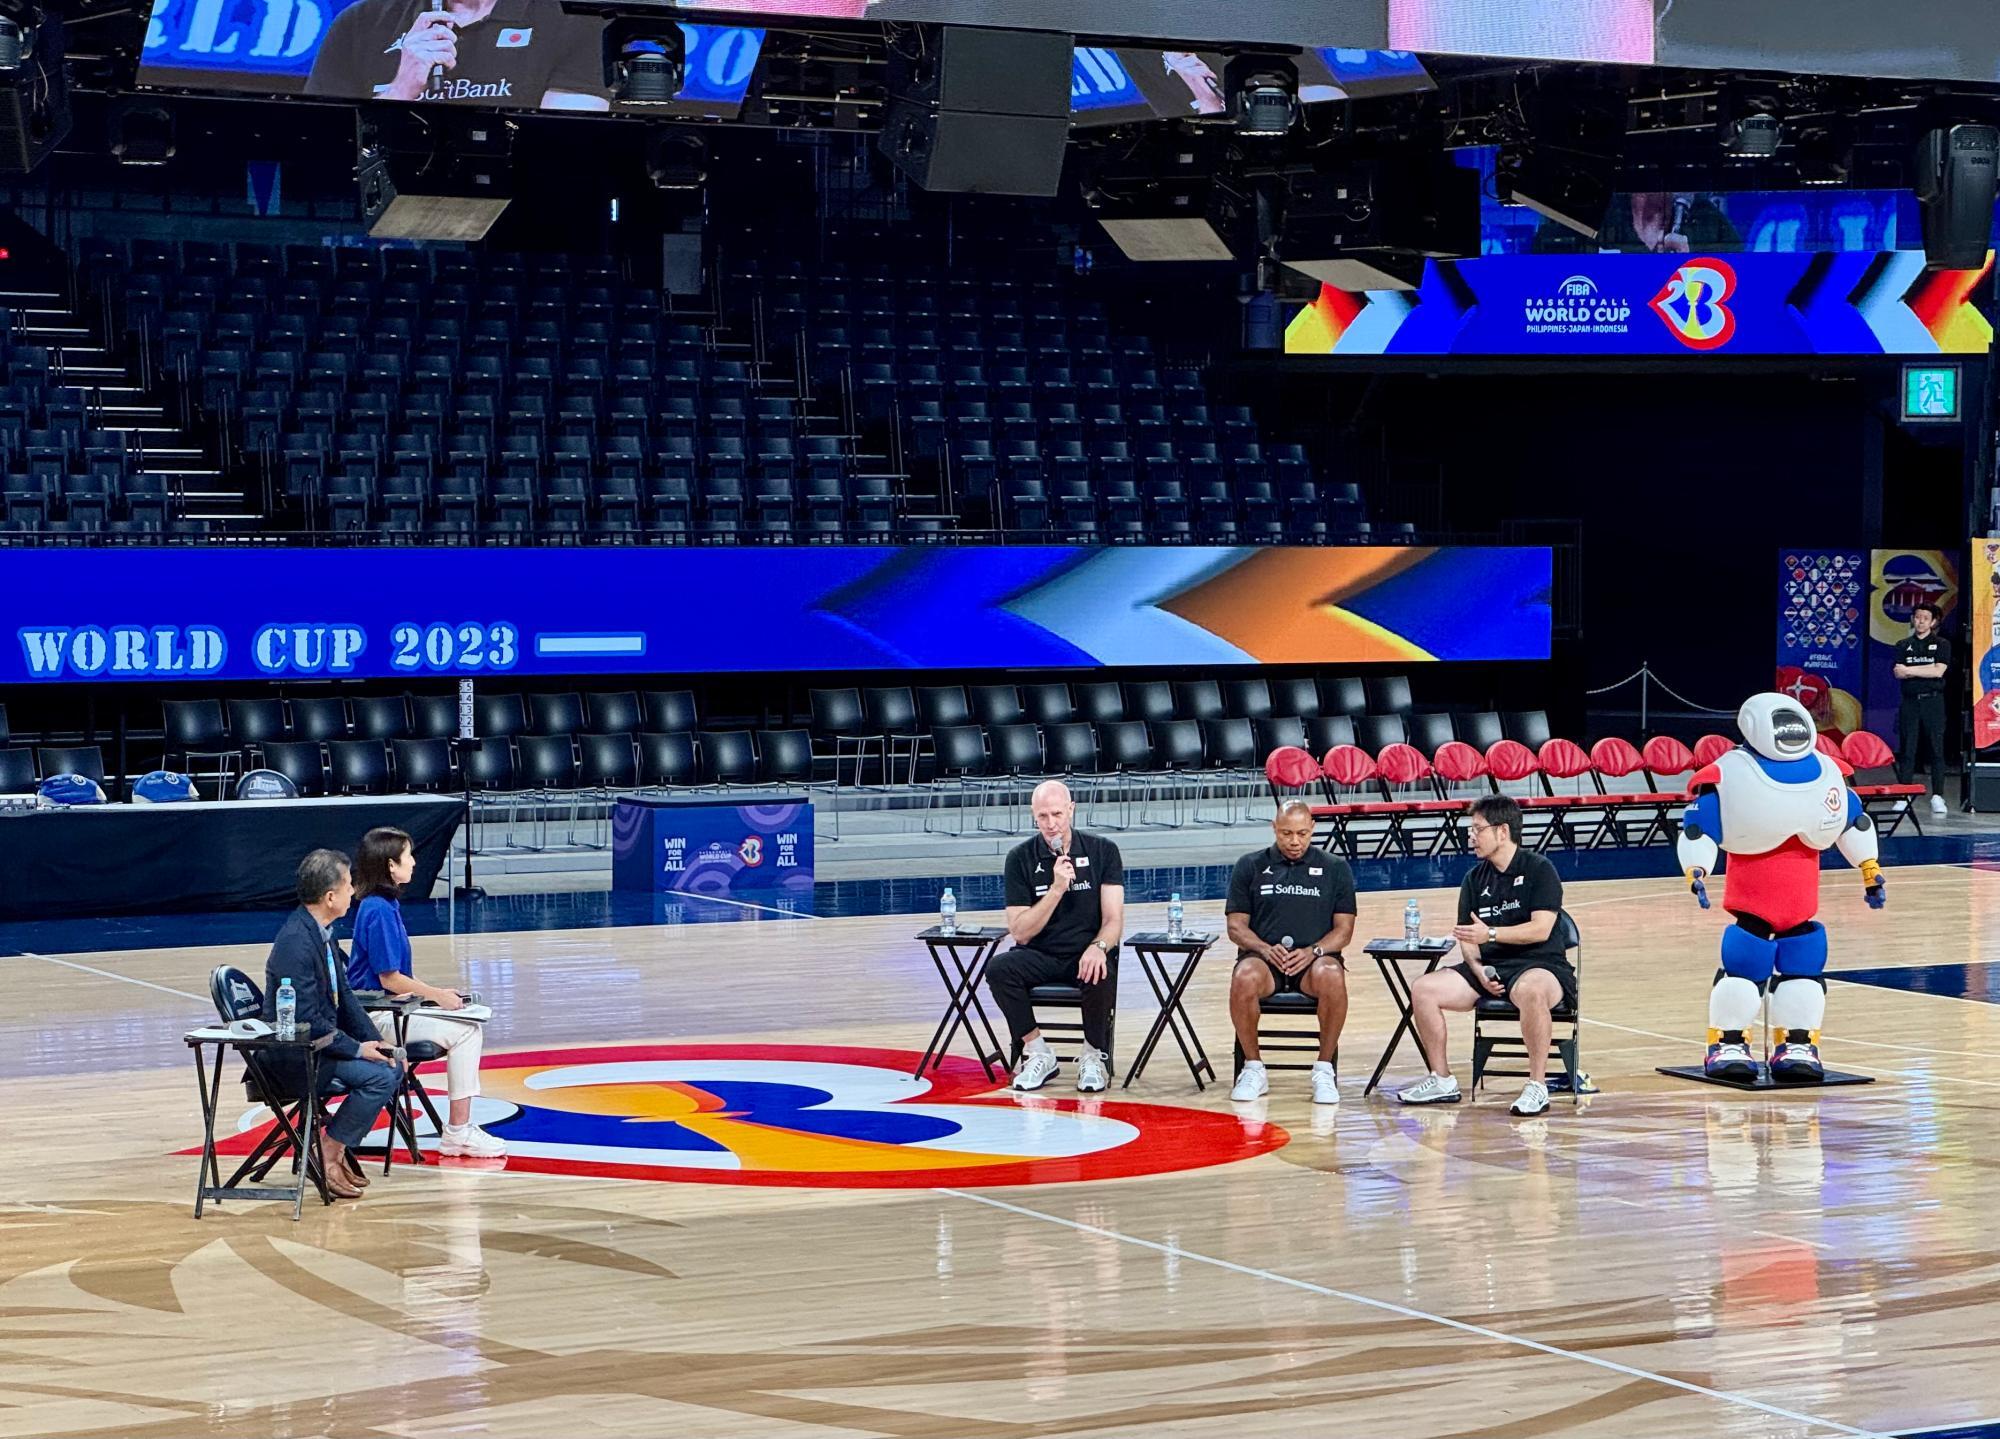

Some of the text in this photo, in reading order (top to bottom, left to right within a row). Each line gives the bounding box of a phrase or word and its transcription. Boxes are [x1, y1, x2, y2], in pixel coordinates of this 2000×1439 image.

[414, 78, 512, 101] oftBank
[1566, 283, 1590, 296] FIBA
[1526, 298, 1628, 307] BASKETBALL
[1525, 307, 1630, 322] WORLD CUP
[23, 625, 516, 673] WORLD CUP 2023
[664, 838, 686, 849] WIN
[777, 833, 798, 845] WIN
[780, 844, 794, 852] FOR
[664, 861, 686, 872] ALL
[776, 855, 798, 867] ALL
[1275, 884, 1321, 897] SoftBank
[1492, 899, 1521, 916] SoBank
